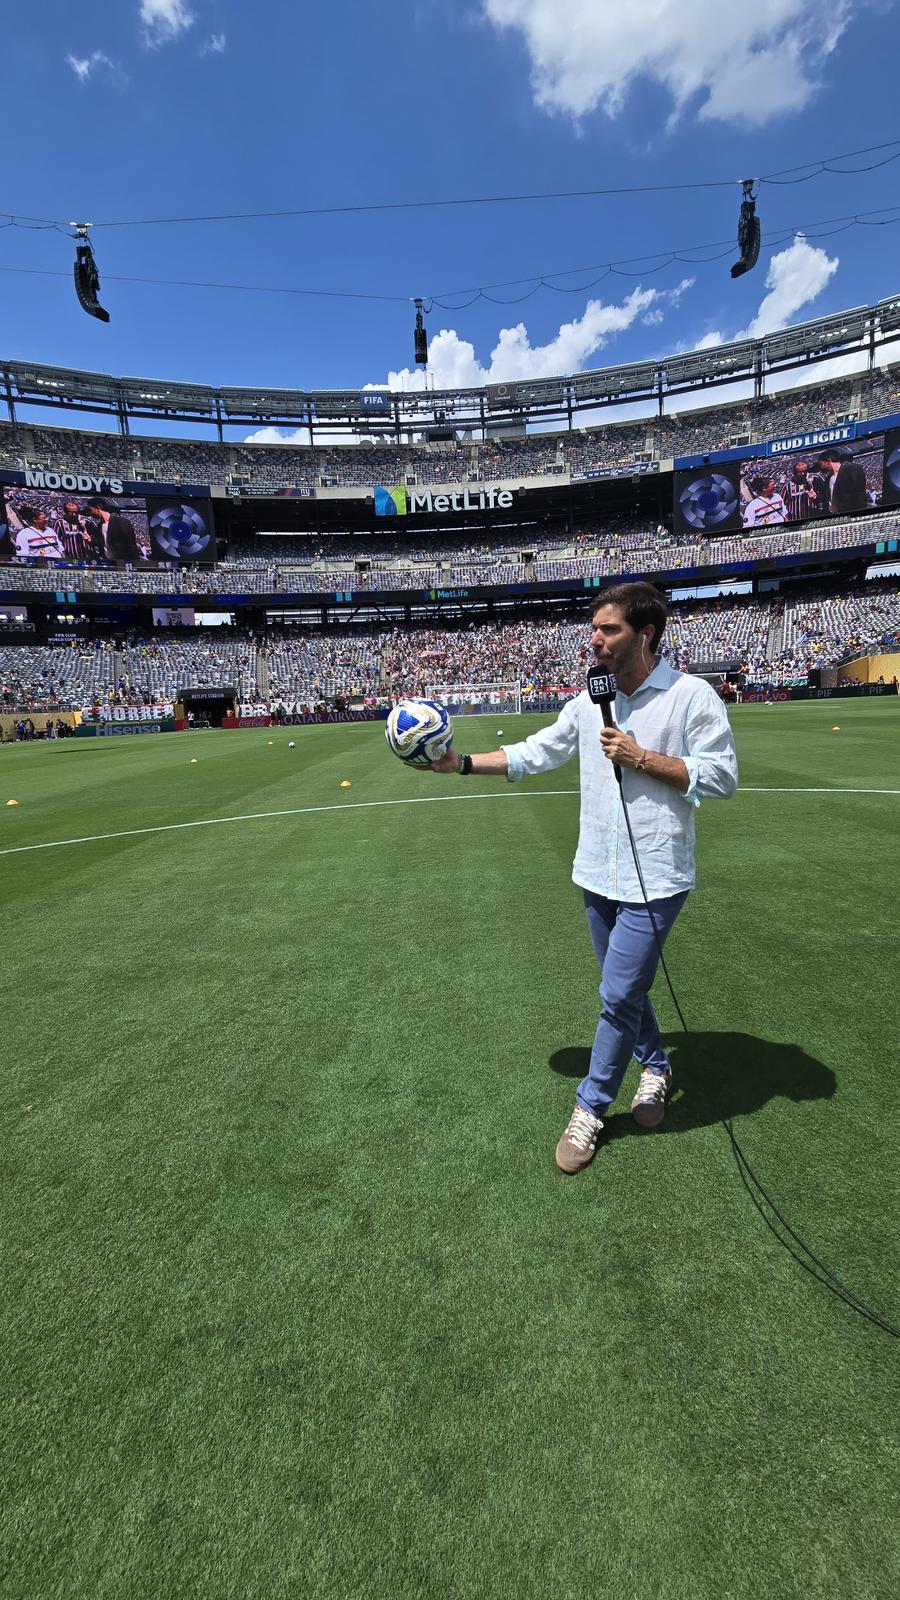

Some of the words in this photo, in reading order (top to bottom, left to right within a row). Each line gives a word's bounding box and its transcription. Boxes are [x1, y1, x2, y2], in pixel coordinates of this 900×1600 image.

[364, 396, 384, 404] FIFA
[771, 438, 803, 453] BUD
[804, 428, 850, 446] LIGHT
[25, 471, 124, 494] MOODY'S
[410, 486, 513, 513] MetLife
[437, 589, 469, 599] MetLife
[744, 691, 787, 703] enovo
[817, 688, 832, 698] PIF
[525, 701, 562, 712] AMERIC
[284, 713, 322, 725] QATAR
[327, 710, 376, 723] AIRWAYS
[96, 724, 161, 736] Hisense
